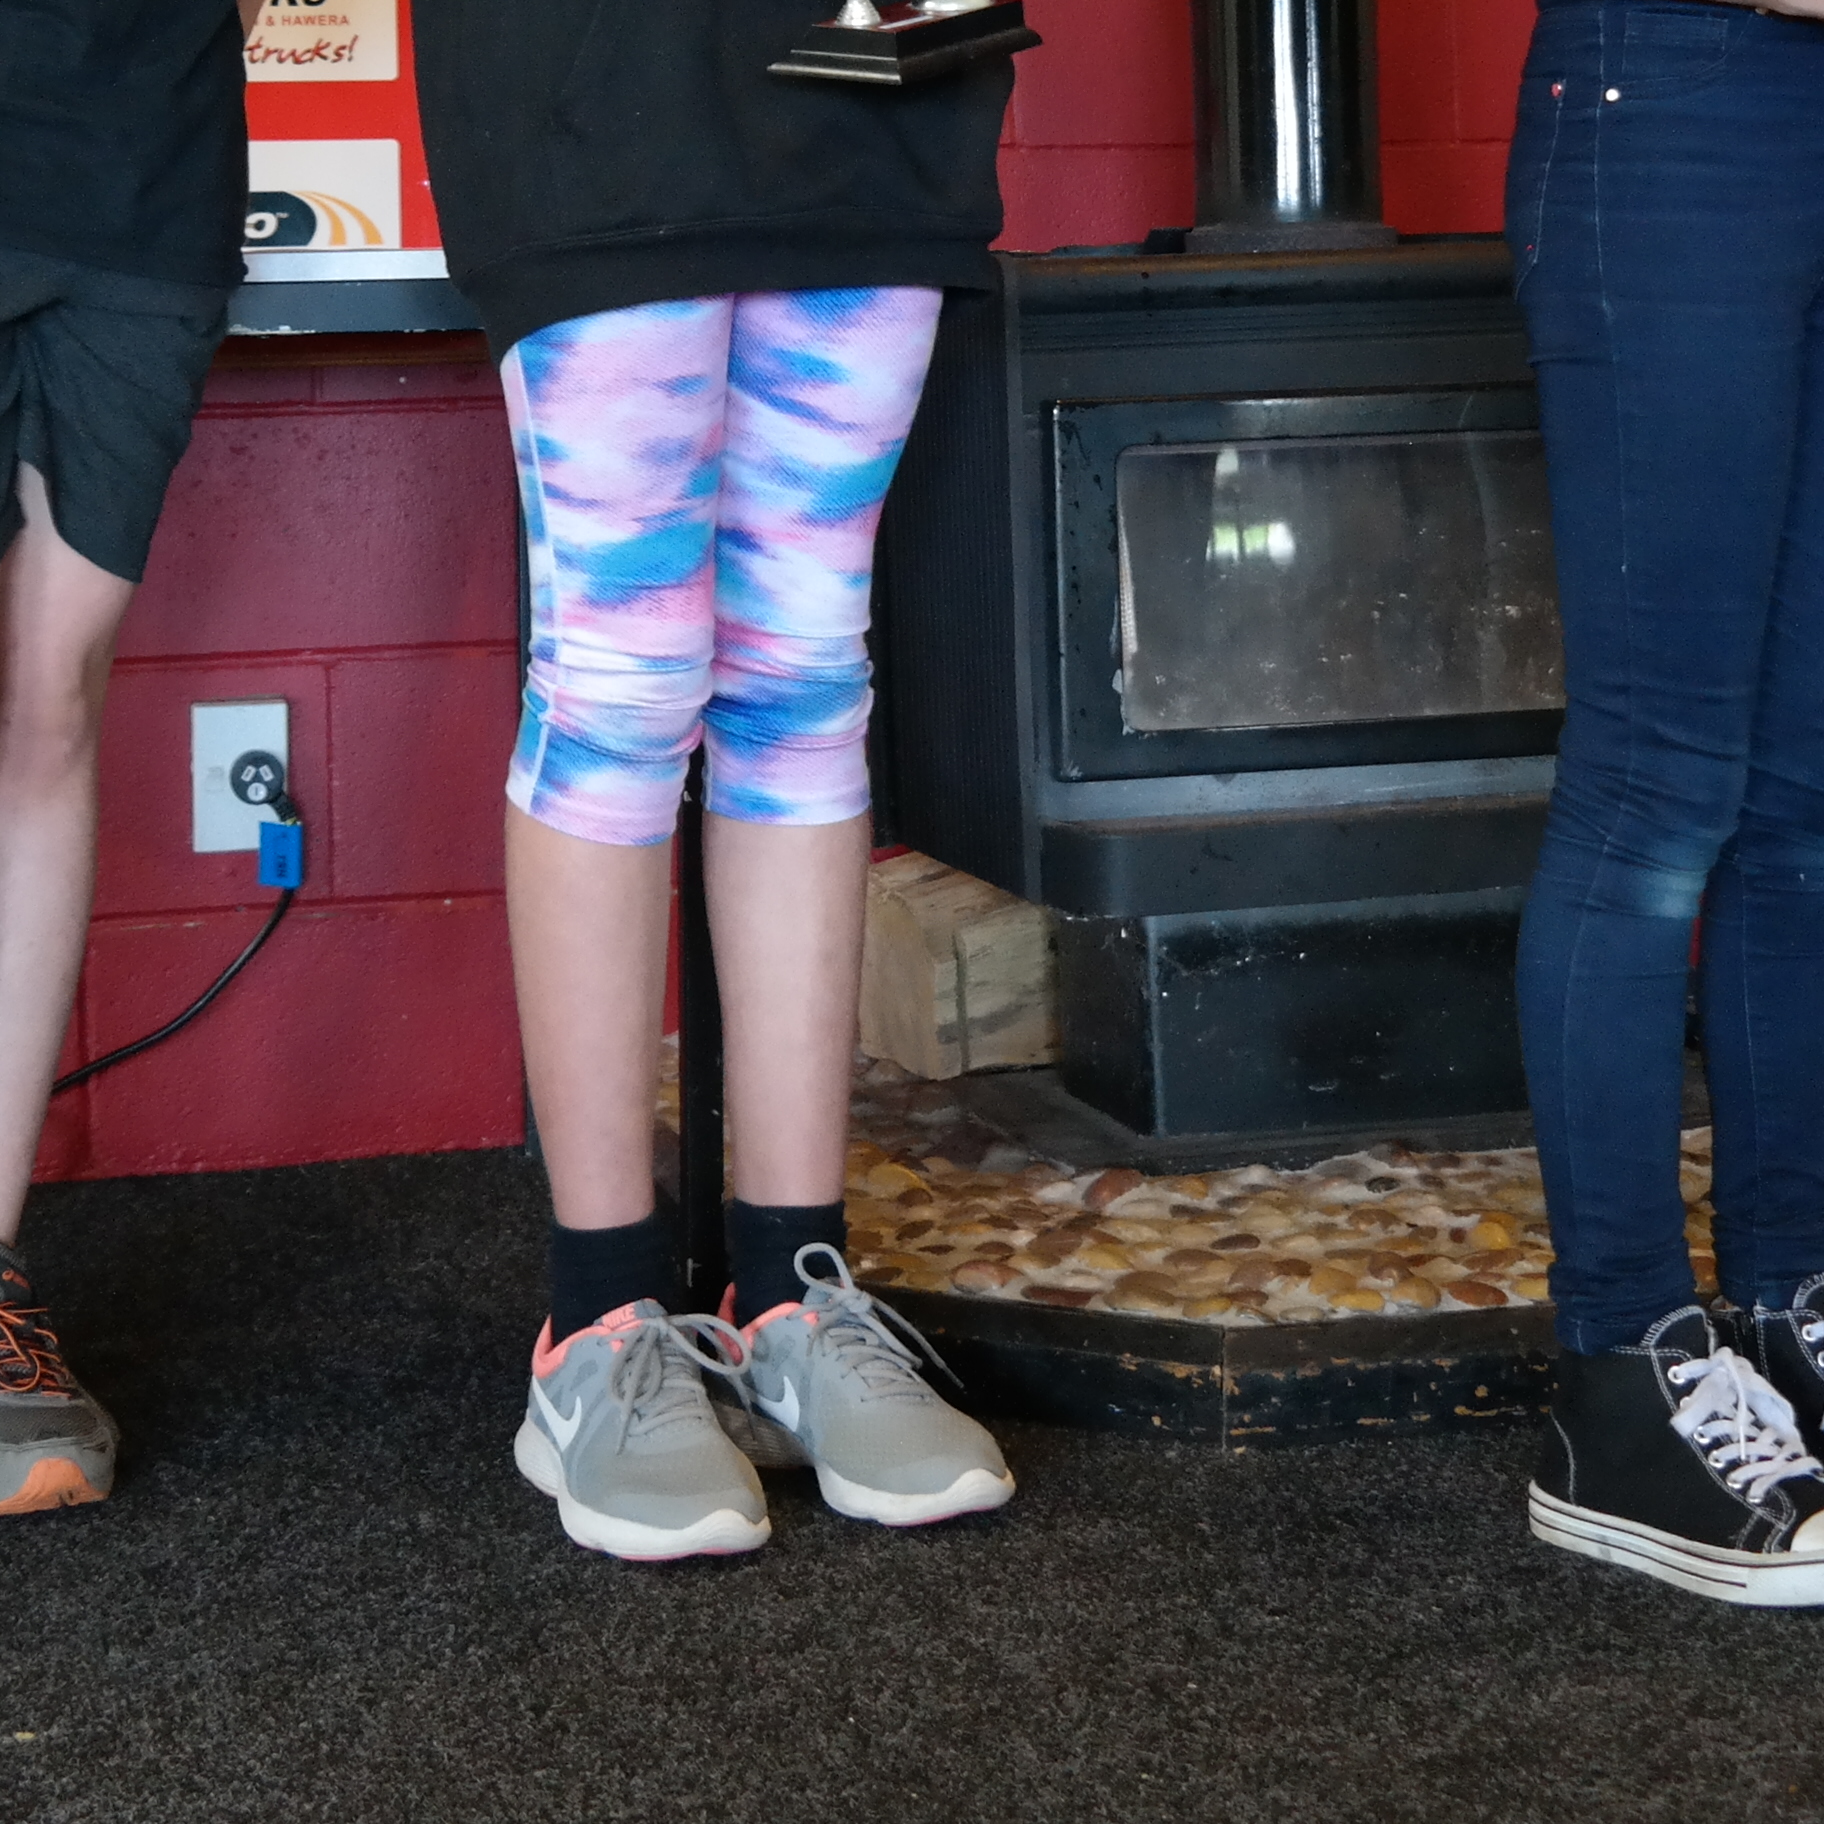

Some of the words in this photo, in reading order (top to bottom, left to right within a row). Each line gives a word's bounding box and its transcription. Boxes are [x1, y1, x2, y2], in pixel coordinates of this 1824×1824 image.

[265, 16, 276, 27] &
[281, 15, 350, 27] HAWERA
[244, 35, 359, 65] trucks!
